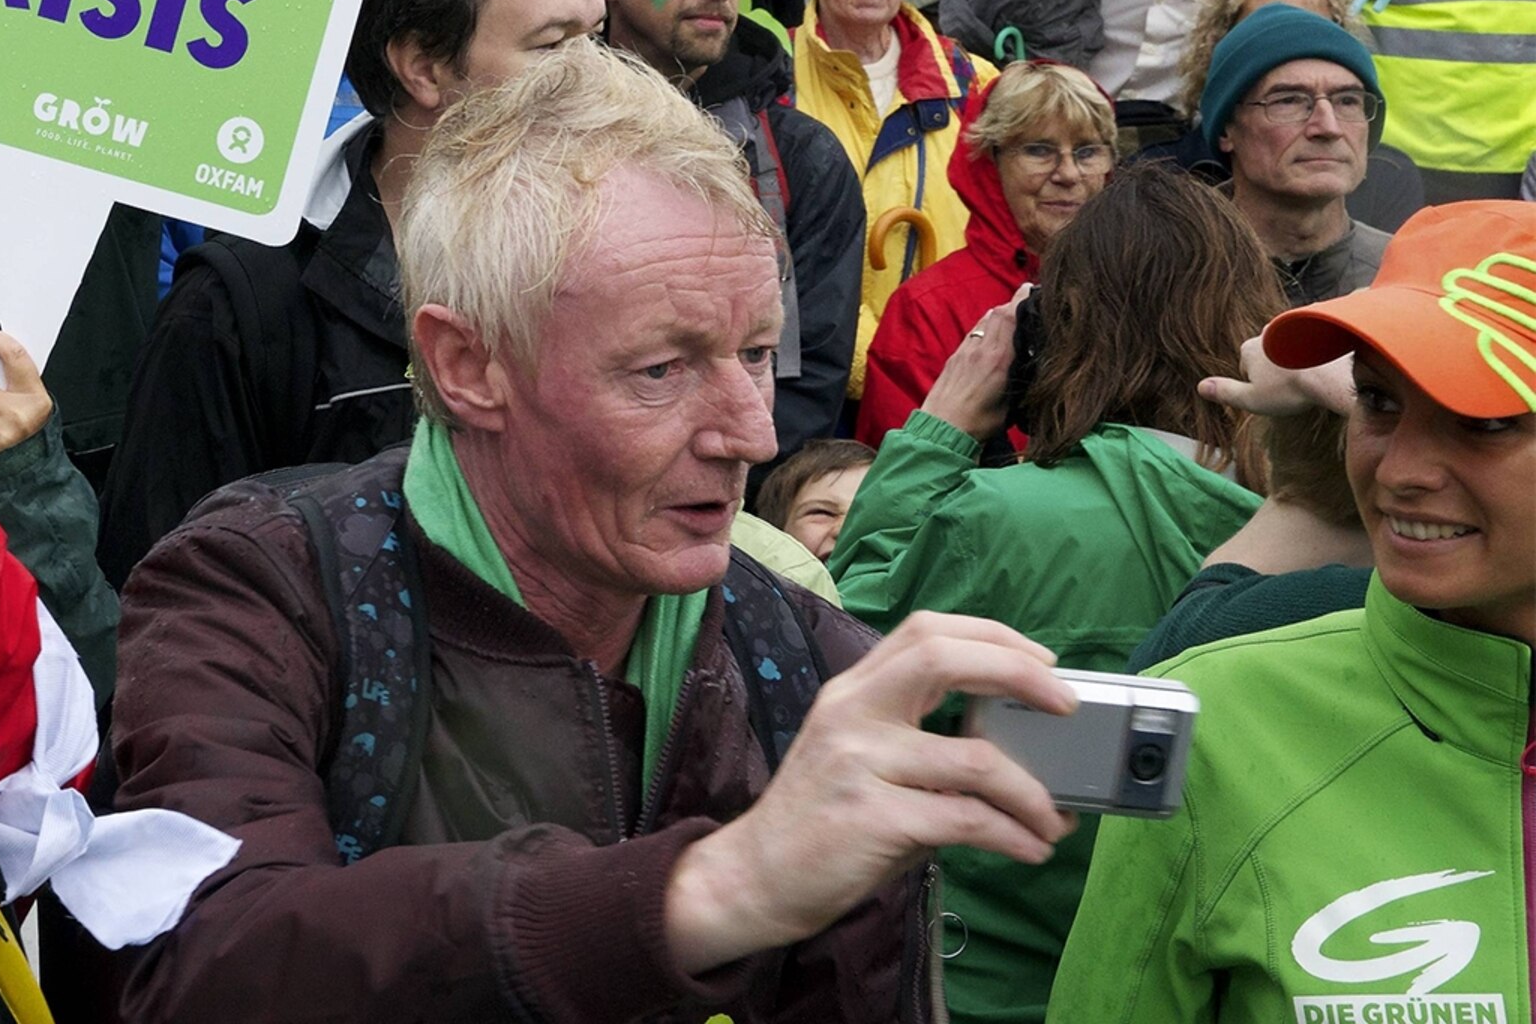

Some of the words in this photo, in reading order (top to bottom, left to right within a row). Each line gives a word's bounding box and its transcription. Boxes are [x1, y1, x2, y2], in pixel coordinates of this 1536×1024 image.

[33, 93, 149, 148] GROW
[195, 163, 264, 199] OXFAM
[1303, 1003, 1355, 1024] DIE
[1361, 997, 1497, 1024] GRÜNEN
